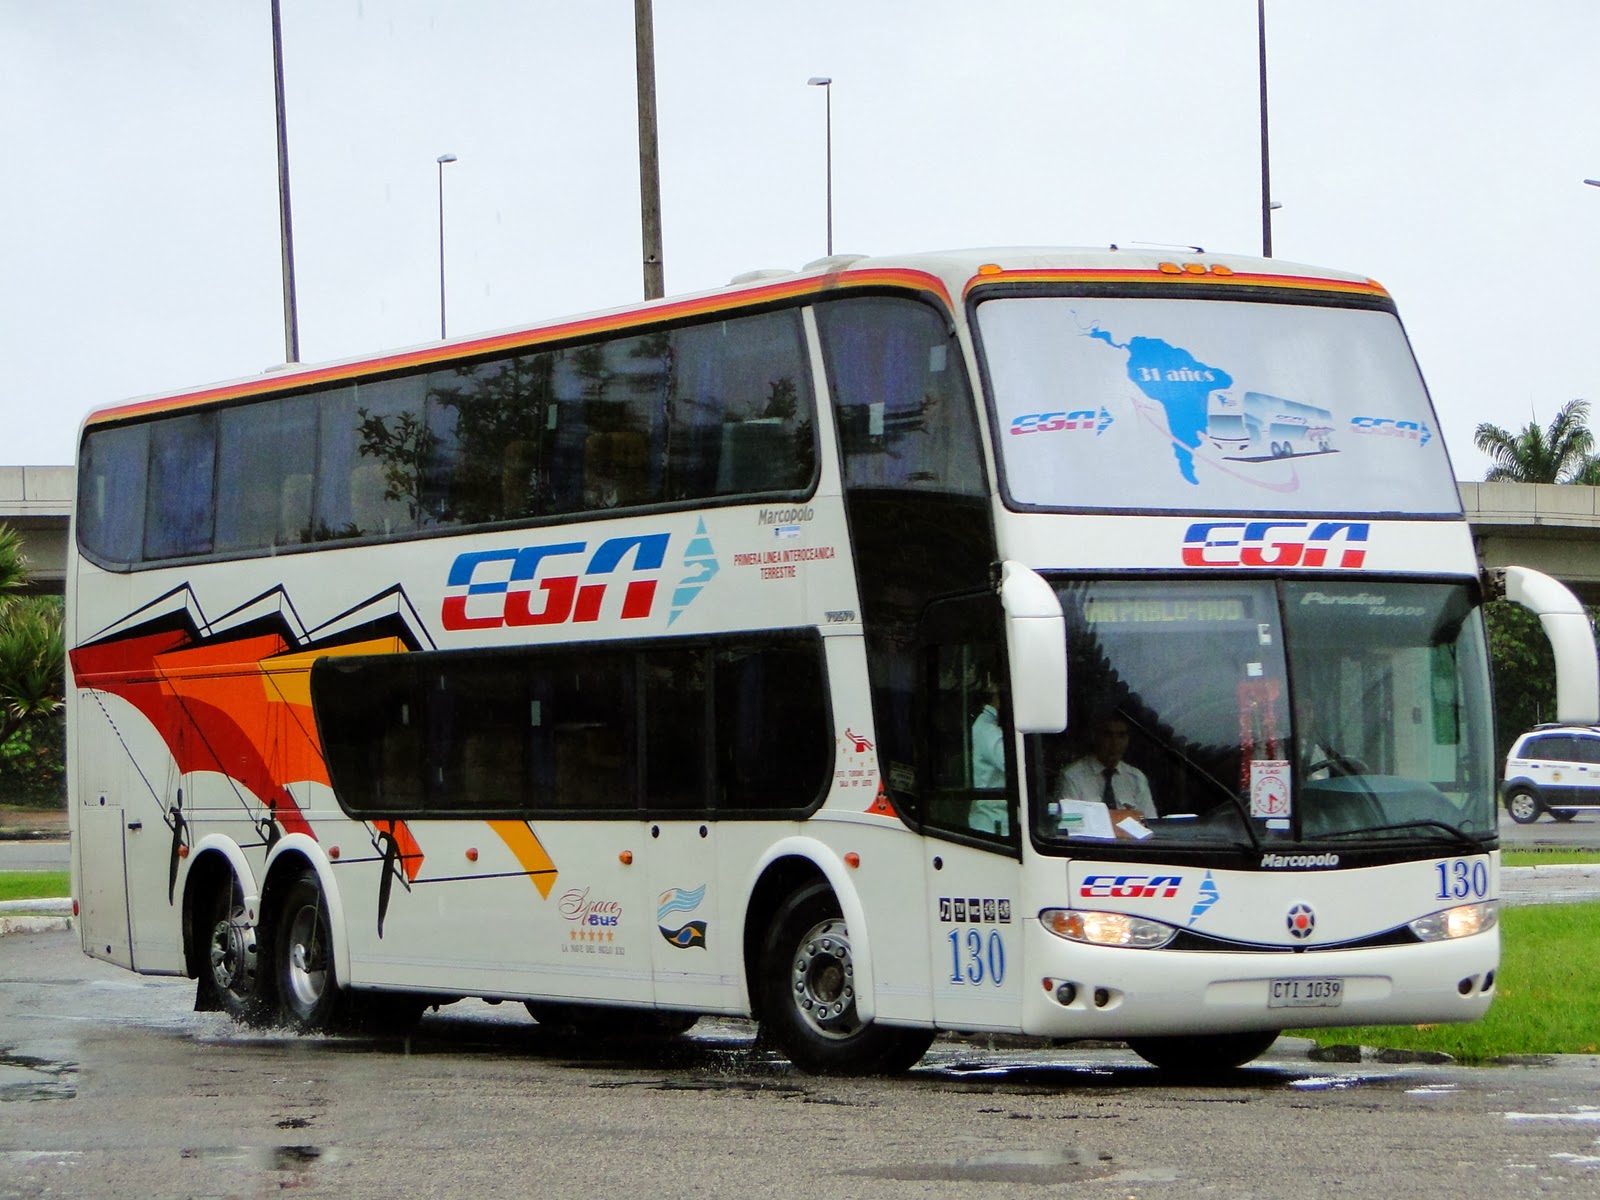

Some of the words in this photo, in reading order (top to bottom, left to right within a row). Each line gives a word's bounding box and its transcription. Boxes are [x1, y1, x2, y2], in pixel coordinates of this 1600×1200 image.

[1166, 366, 1215, 382] años
[1010, 409, 1095, 436] EGA
[758, 506, 814, 525] Marcopolo
[1182, 522, 1370, 568] EGA
[733, 552, 762, 566] PRIMERA
[763, 550, 781, 564] LINEA
[441, 532, 671, 632] EGA
[760, 565, 796, 580] TERRESTRE
[1261, 853, 1340, 868] Marcopolo
[1080, 875, 1183, 898] EGA
[1435, 859, 1488, 901] 130
[558, 886, 623, 926] Space
[947, 927, 1005, 987] 130
[1273, 982, 1299, 998] CTI
[1306, 982, 1340, 998] 1039
